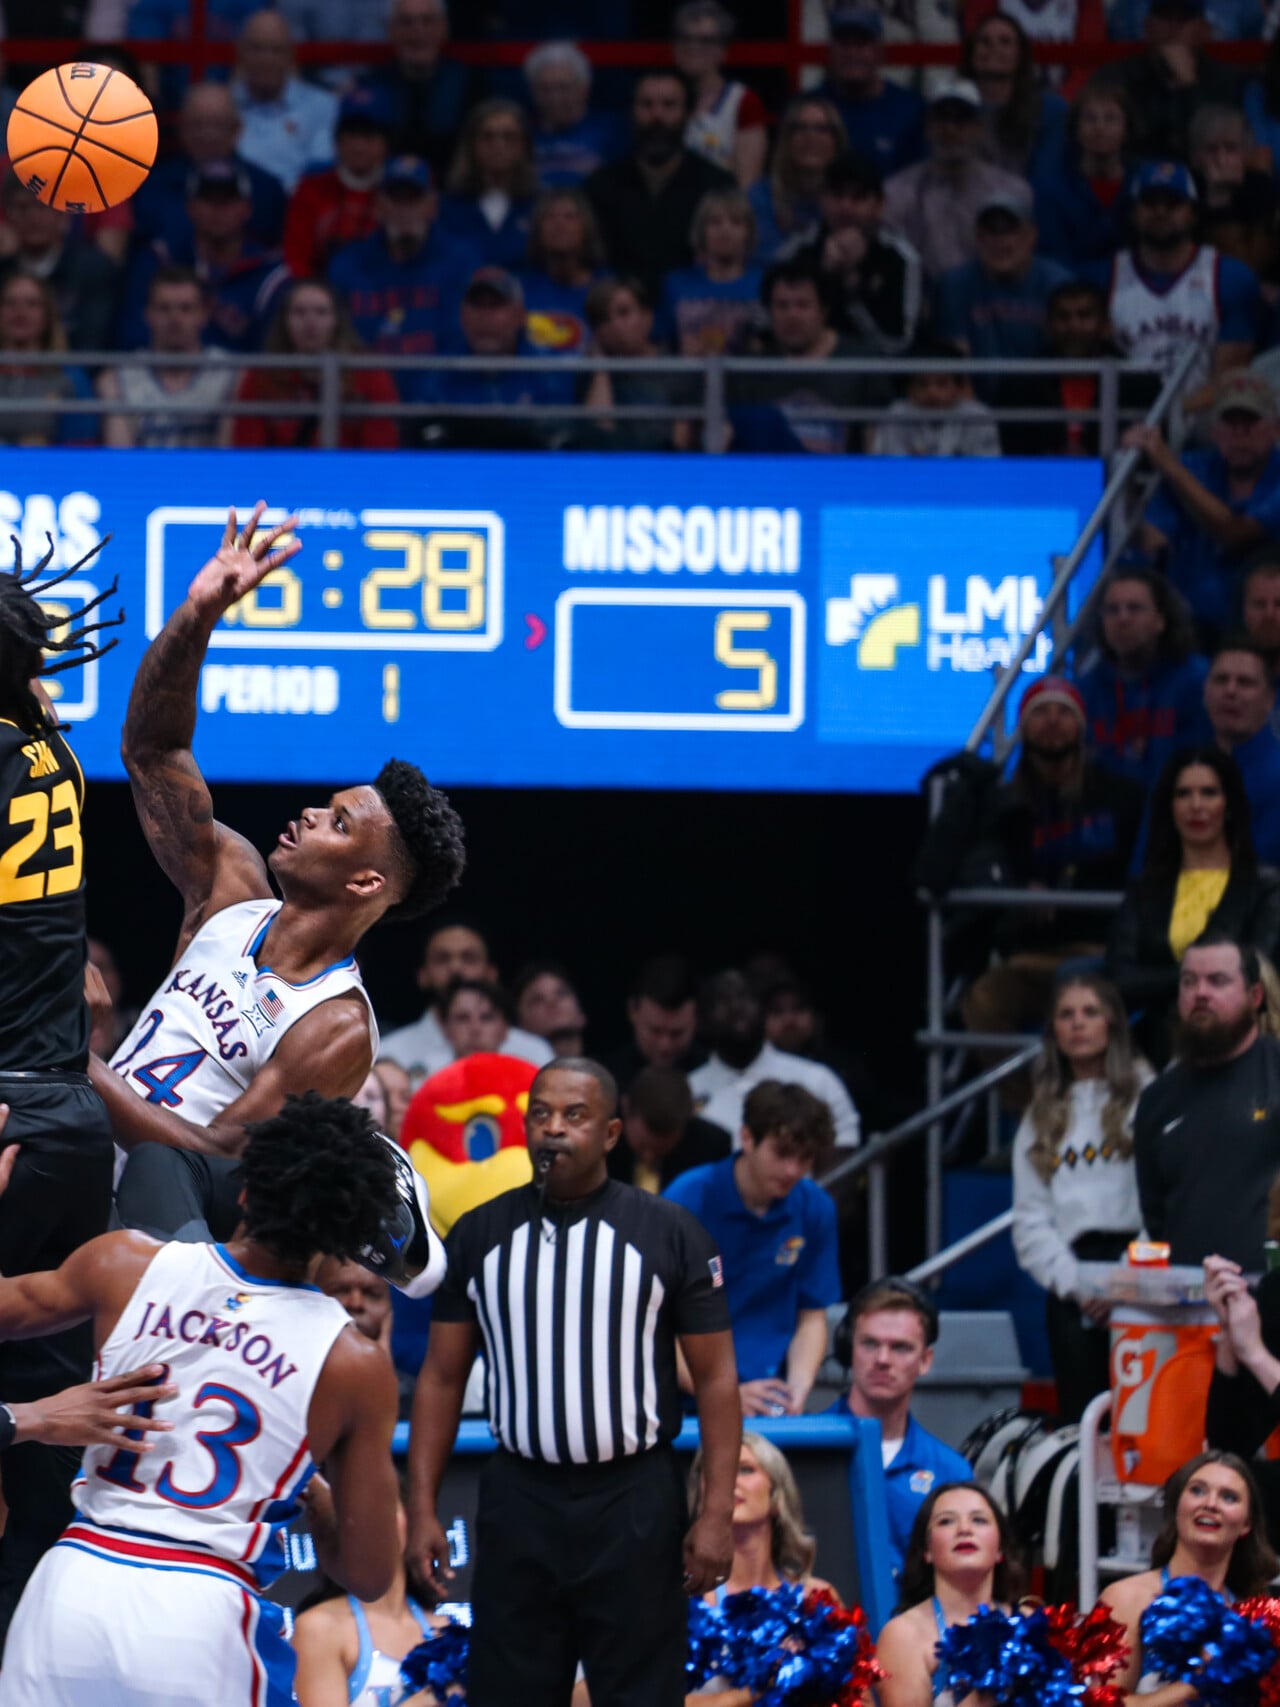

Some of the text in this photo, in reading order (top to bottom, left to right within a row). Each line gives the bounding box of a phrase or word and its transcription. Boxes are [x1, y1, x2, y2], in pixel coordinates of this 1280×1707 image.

[563, 506, 800, 574] MISSOURI
[201, 662, 400, 724] PERIOD 1
[714, 610, 777, 709] 5
[165, 969, 248, 1061] KANSAS
[132, 1301, 298, 1389] JACKSON
[95, 1363, 263, 1510] 13
